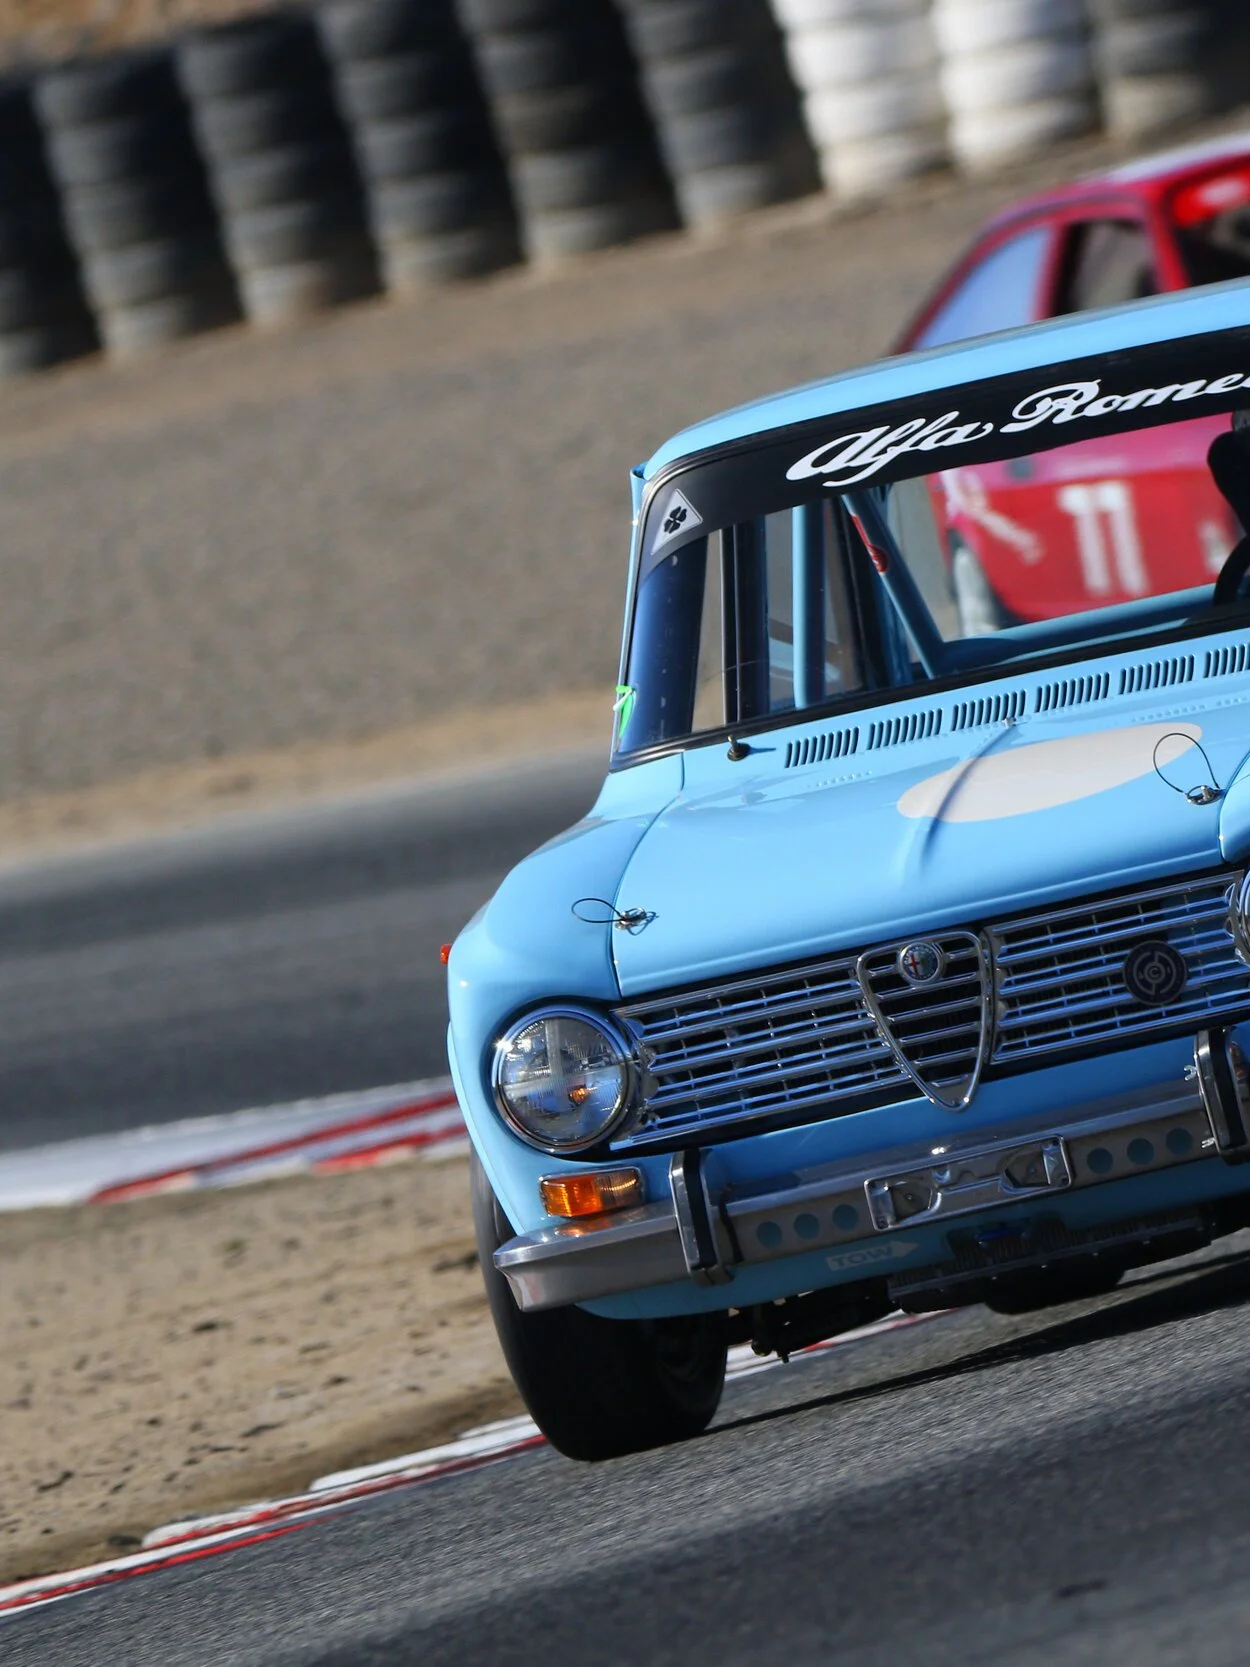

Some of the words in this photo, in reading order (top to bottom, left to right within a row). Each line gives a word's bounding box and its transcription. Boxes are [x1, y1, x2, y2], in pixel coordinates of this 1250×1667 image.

[786, 410, 993, 487] Alfa
[1057, 480, 1149, 598] 11
[831, 1245, 894, 1267] TOW
